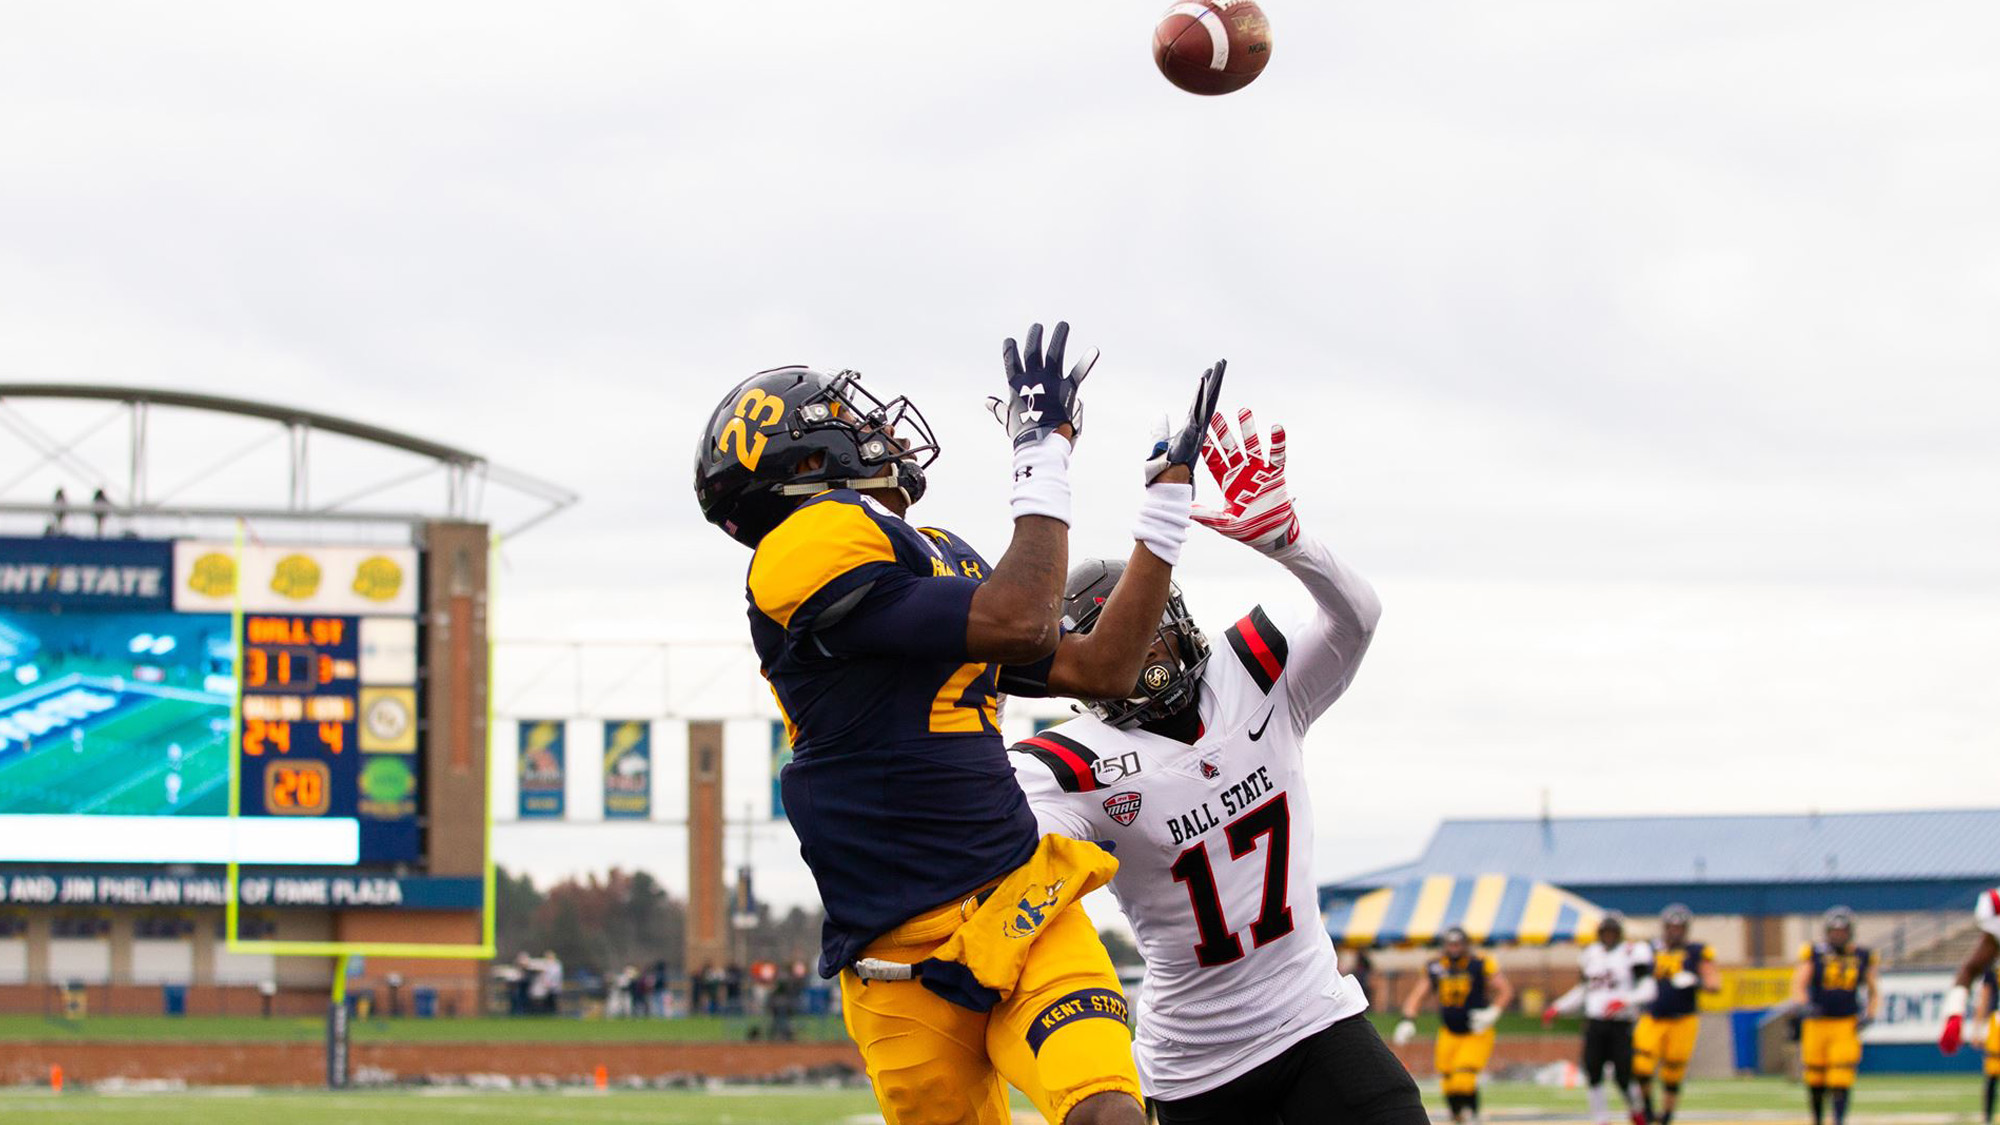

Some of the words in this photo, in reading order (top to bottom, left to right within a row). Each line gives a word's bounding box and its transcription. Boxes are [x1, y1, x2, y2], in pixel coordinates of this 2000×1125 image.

[719, 388, 785, 472] 23
[0, 564, 48, 593] NT
[59, 565, 162, 597] STATE
[247, 648, 291, 687] 31
[929, 663, 1003, 733] 2
[243, 717, 291, 756] 24
[318, 721, 343, 754] 4
[1096, 751, 1142, 783] 150
[274, 768, 322, 808] 20
[1167, 803, 1220, 846] BALL
[1220, 765, 1274, 818] STATE
[1107, 800, 1141, 816] MAC
[10, 876, 57, 902] AND
[60, 877, 96, 902] JIM
[98, 877, 181, 904] PHELAN
[241, 878, 271, 904] OF
[274, 878, 329, 904] FAME
[332, 878, 403, 904] PLAZA
[1170, 791, 1295, 968] 17
[1041, 999, 1084, 1029] KENT
[1886, 990, 1944, 1023] ENT
